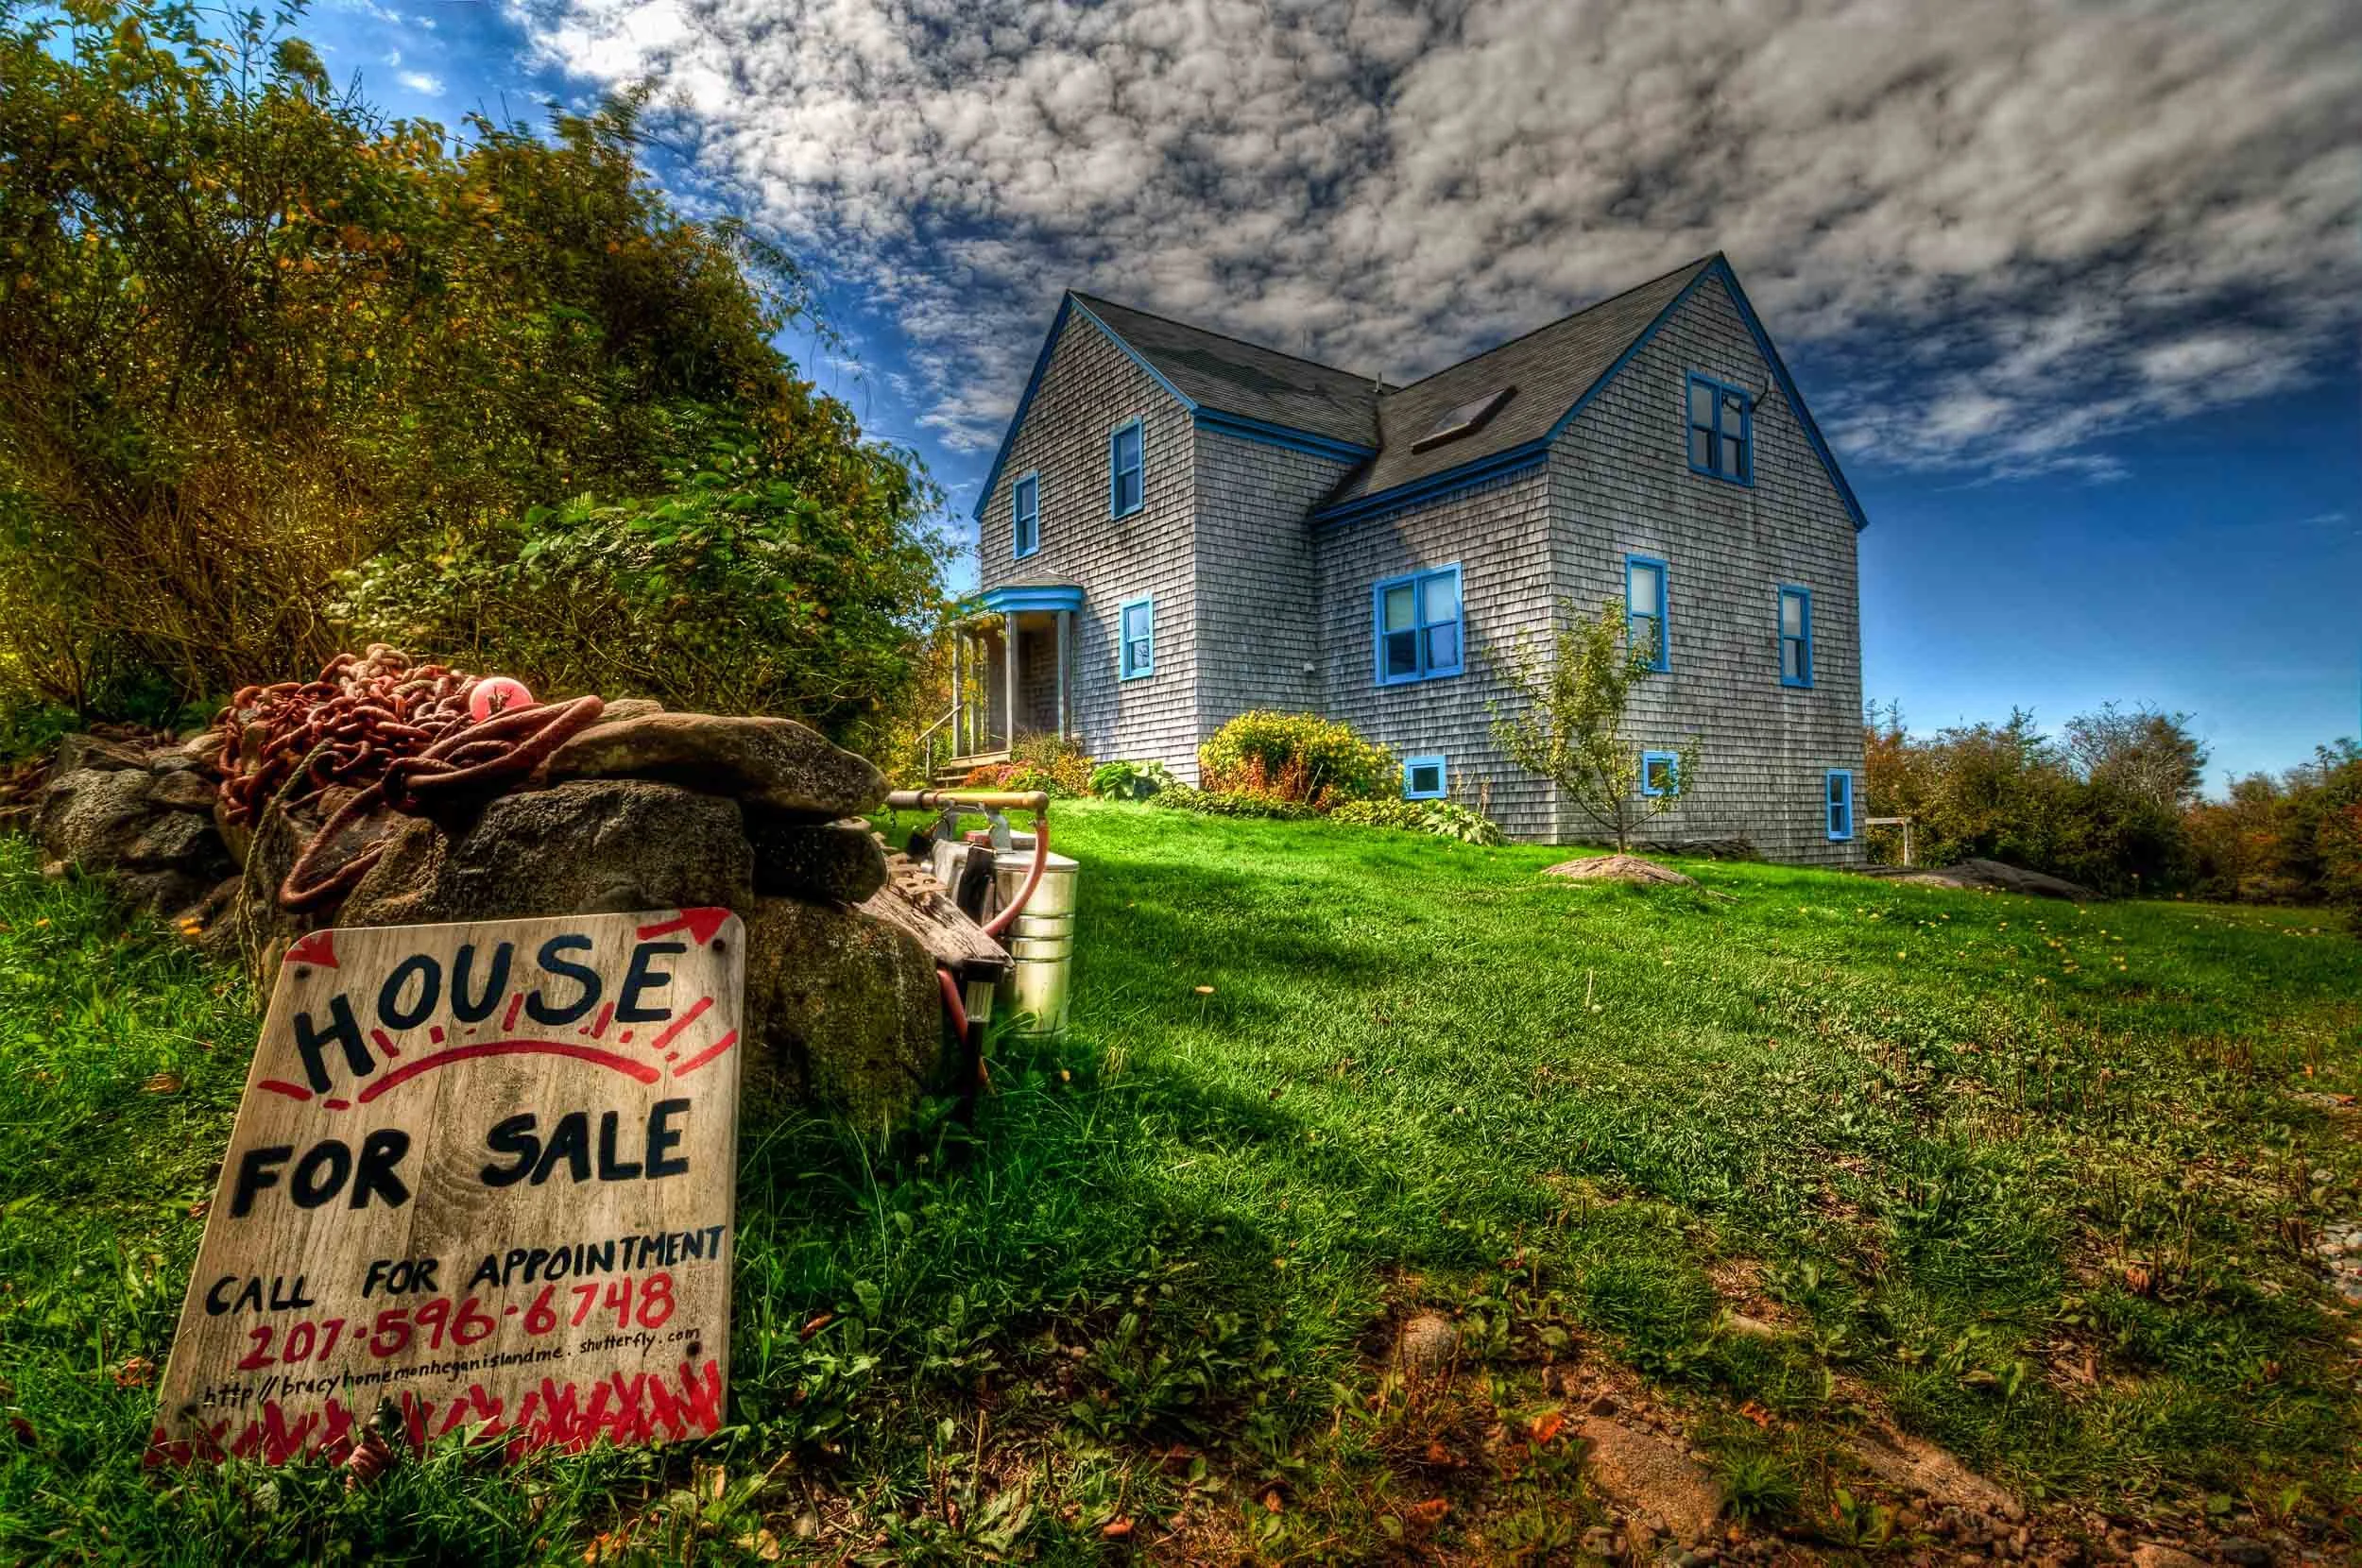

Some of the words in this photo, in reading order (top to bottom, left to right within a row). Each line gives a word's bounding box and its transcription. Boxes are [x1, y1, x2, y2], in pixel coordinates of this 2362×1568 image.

[294, 933, 686, 1094] HOUSE
[230, 1128, 411, 1219] FOR
[480, 1099, 691, 1188] SALE
[205, 1274, 314, 1316] CALL
[363, 1258, 438, 1300] FOR
[472, 1225, 726, 1289] APPOINTMENT
